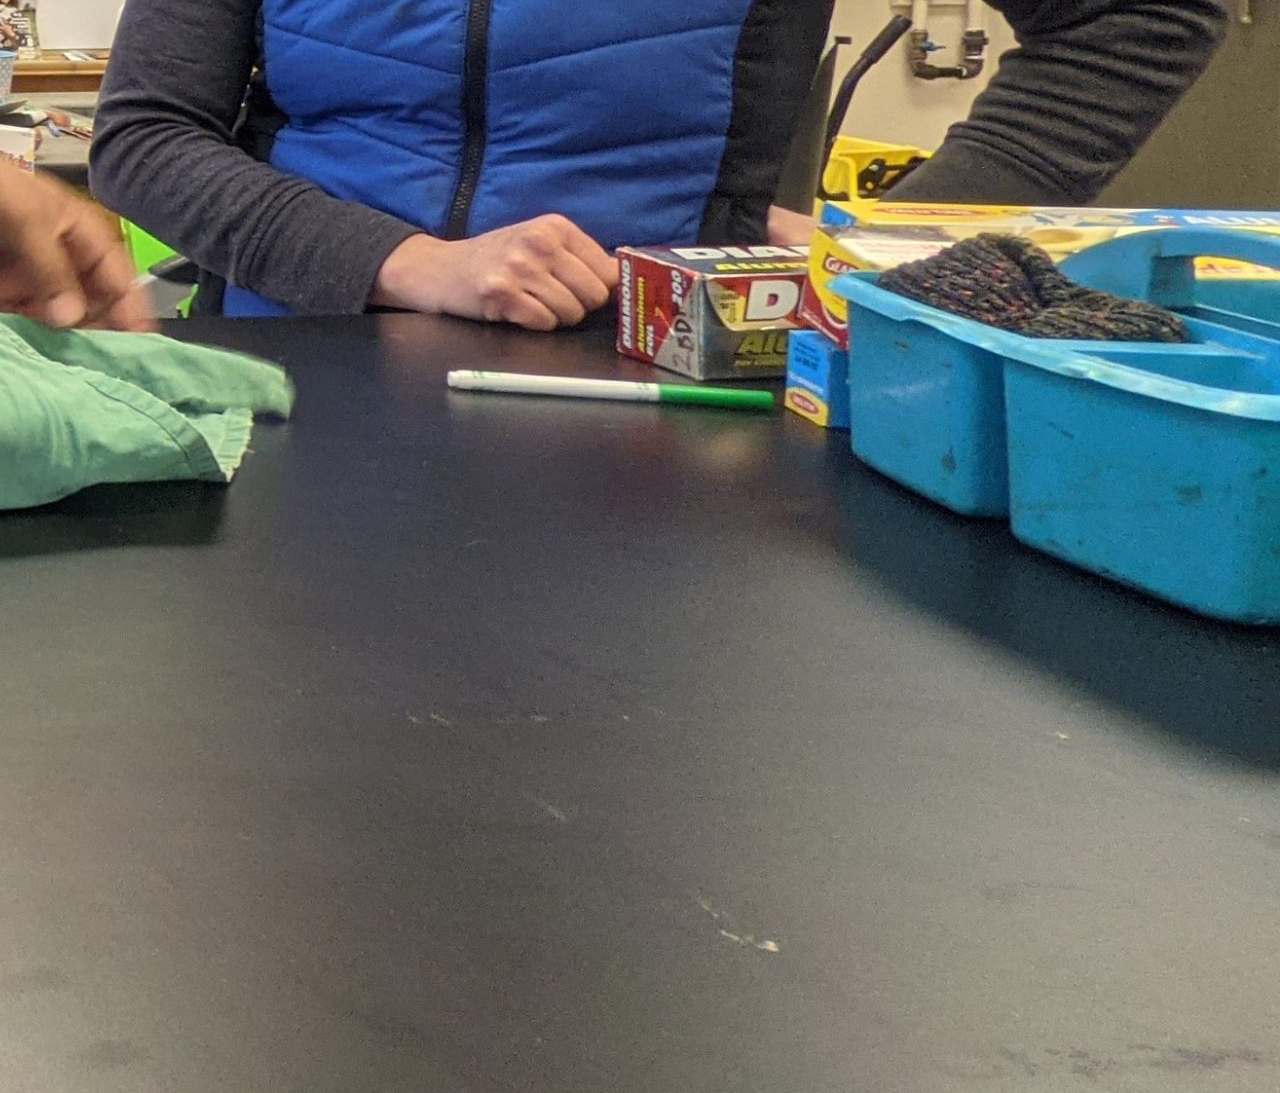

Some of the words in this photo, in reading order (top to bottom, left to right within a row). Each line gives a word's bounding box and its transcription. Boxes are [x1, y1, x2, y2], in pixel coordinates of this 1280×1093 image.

[622, 258, 632, 349] DIAMOND
[637, 276, 646, 353] Aluminum
[646, 325, 655, 357] FOIL
